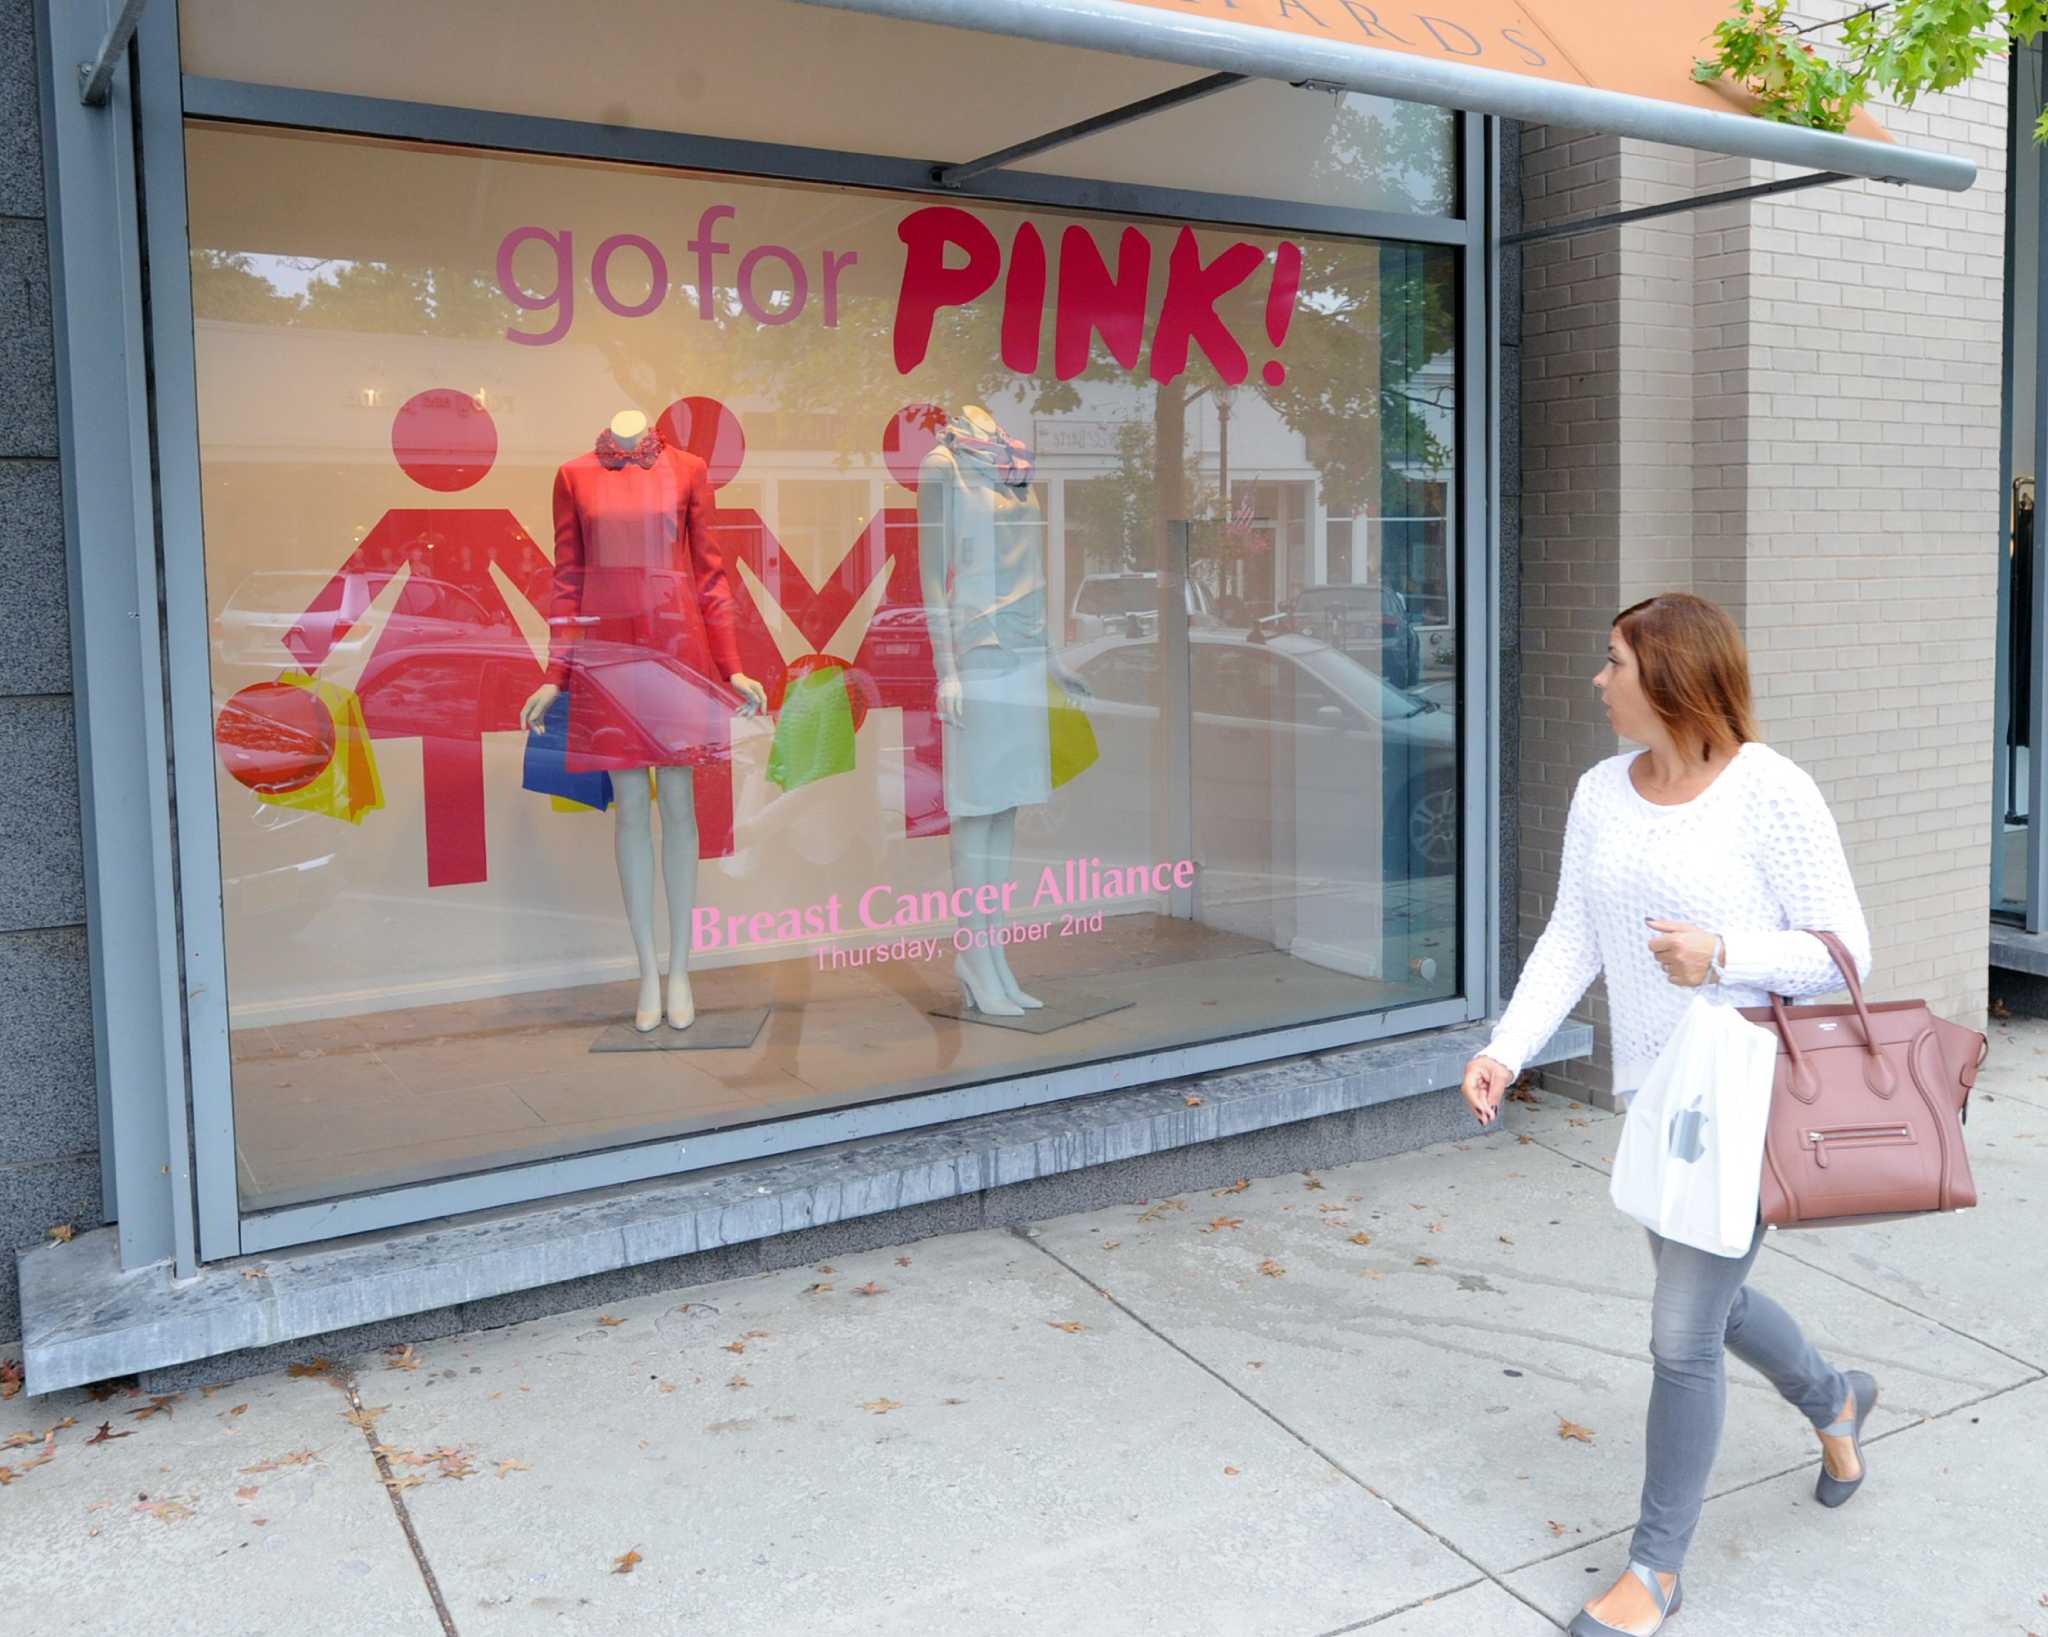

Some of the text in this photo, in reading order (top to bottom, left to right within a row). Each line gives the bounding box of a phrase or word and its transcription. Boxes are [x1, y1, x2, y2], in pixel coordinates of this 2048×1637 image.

[893, 206, 1301, 386] PINK!
[691, 857, 1195, 952] Breast Cancer Alliance
[817, 911, 1104, 971] Thursday, October 2nd
